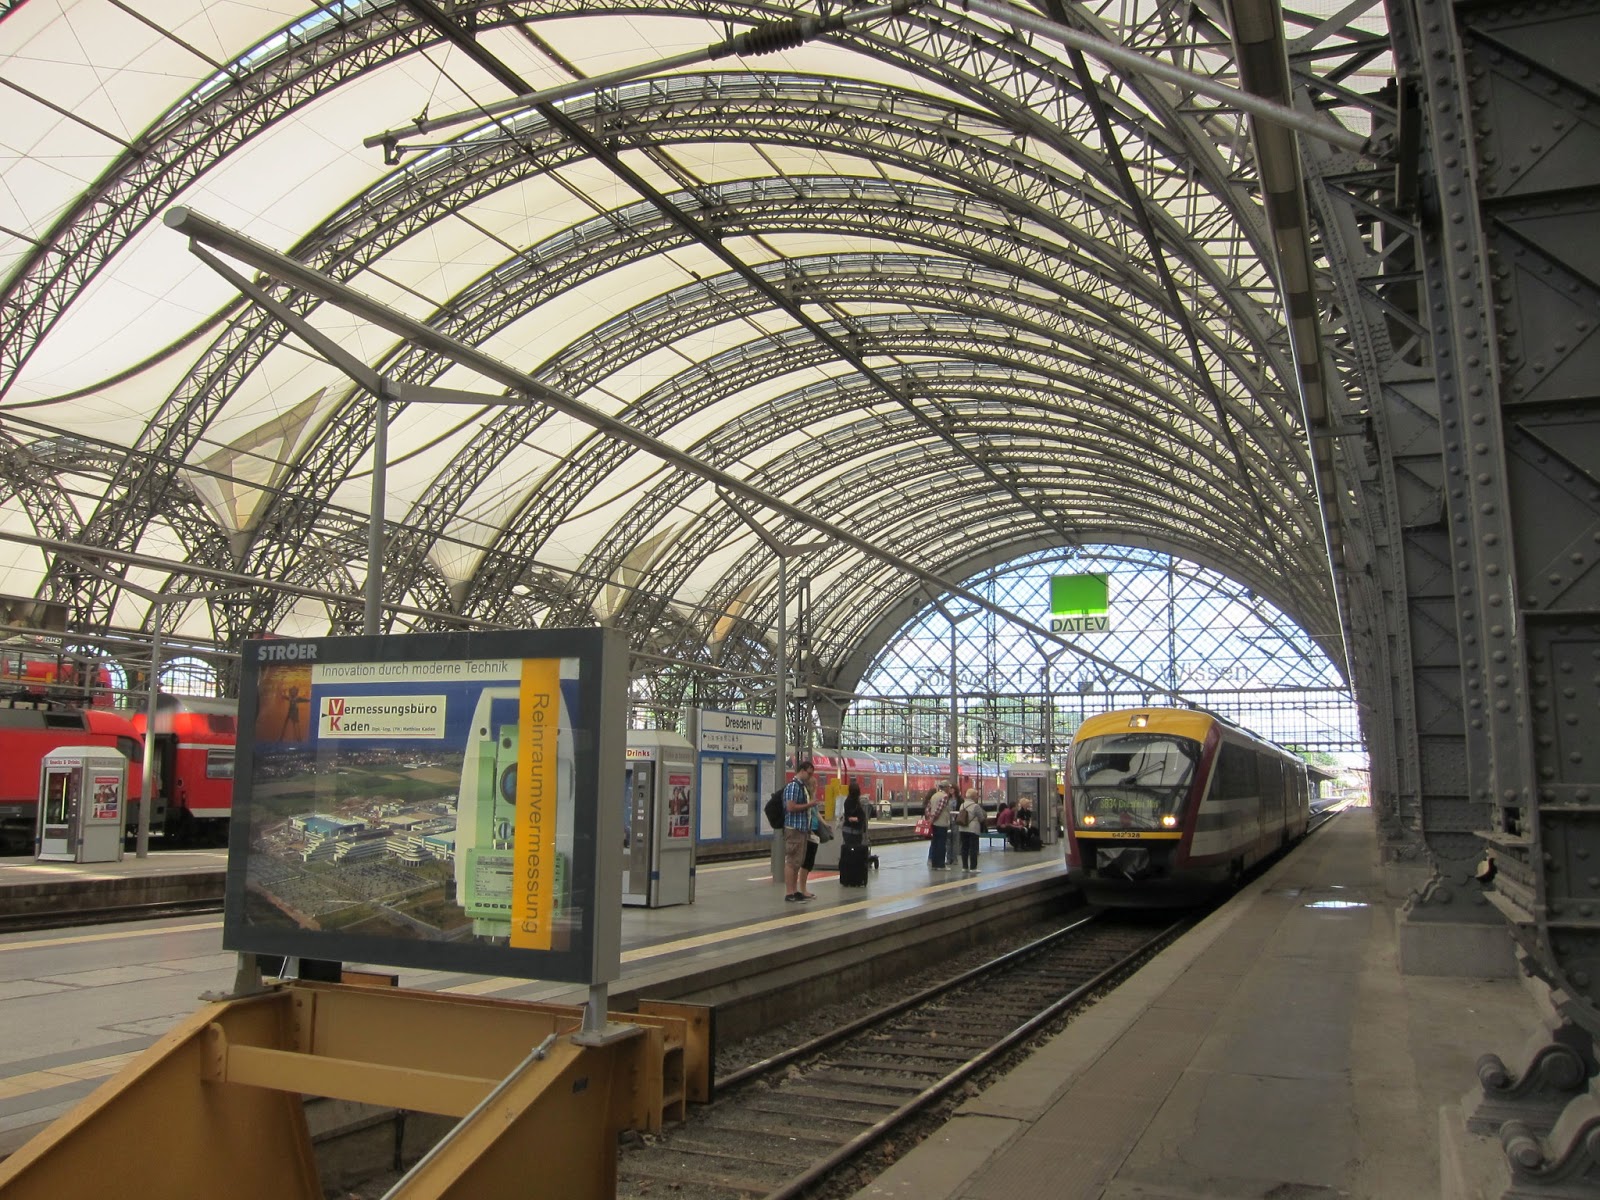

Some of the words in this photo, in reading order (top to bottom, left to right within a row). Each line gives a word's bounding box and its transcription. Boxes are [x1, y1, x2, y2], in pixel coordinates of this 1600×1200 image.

[1051, 616, 1108, 632] DATEV
[257, 643, 318, 661] STRÖER
[321, 664, 375, 677] Innovation
[378, 663, 409, 676] durch
[411, 662, 461, 675] moderne
[465, 660, 508, 674] Technik
[915, 668, 1004, 687] Sofware
[330, 699, 438, 717] Vermessungsbüro
[329, 716, 370, 732] Kaden
[725, 715, 751, 730] Dresden
[751, 718, 763, 731] Hbf
[626, 749, 650, 757] Drinks
[521, 692, 550, 935] Reinraumvermessung
